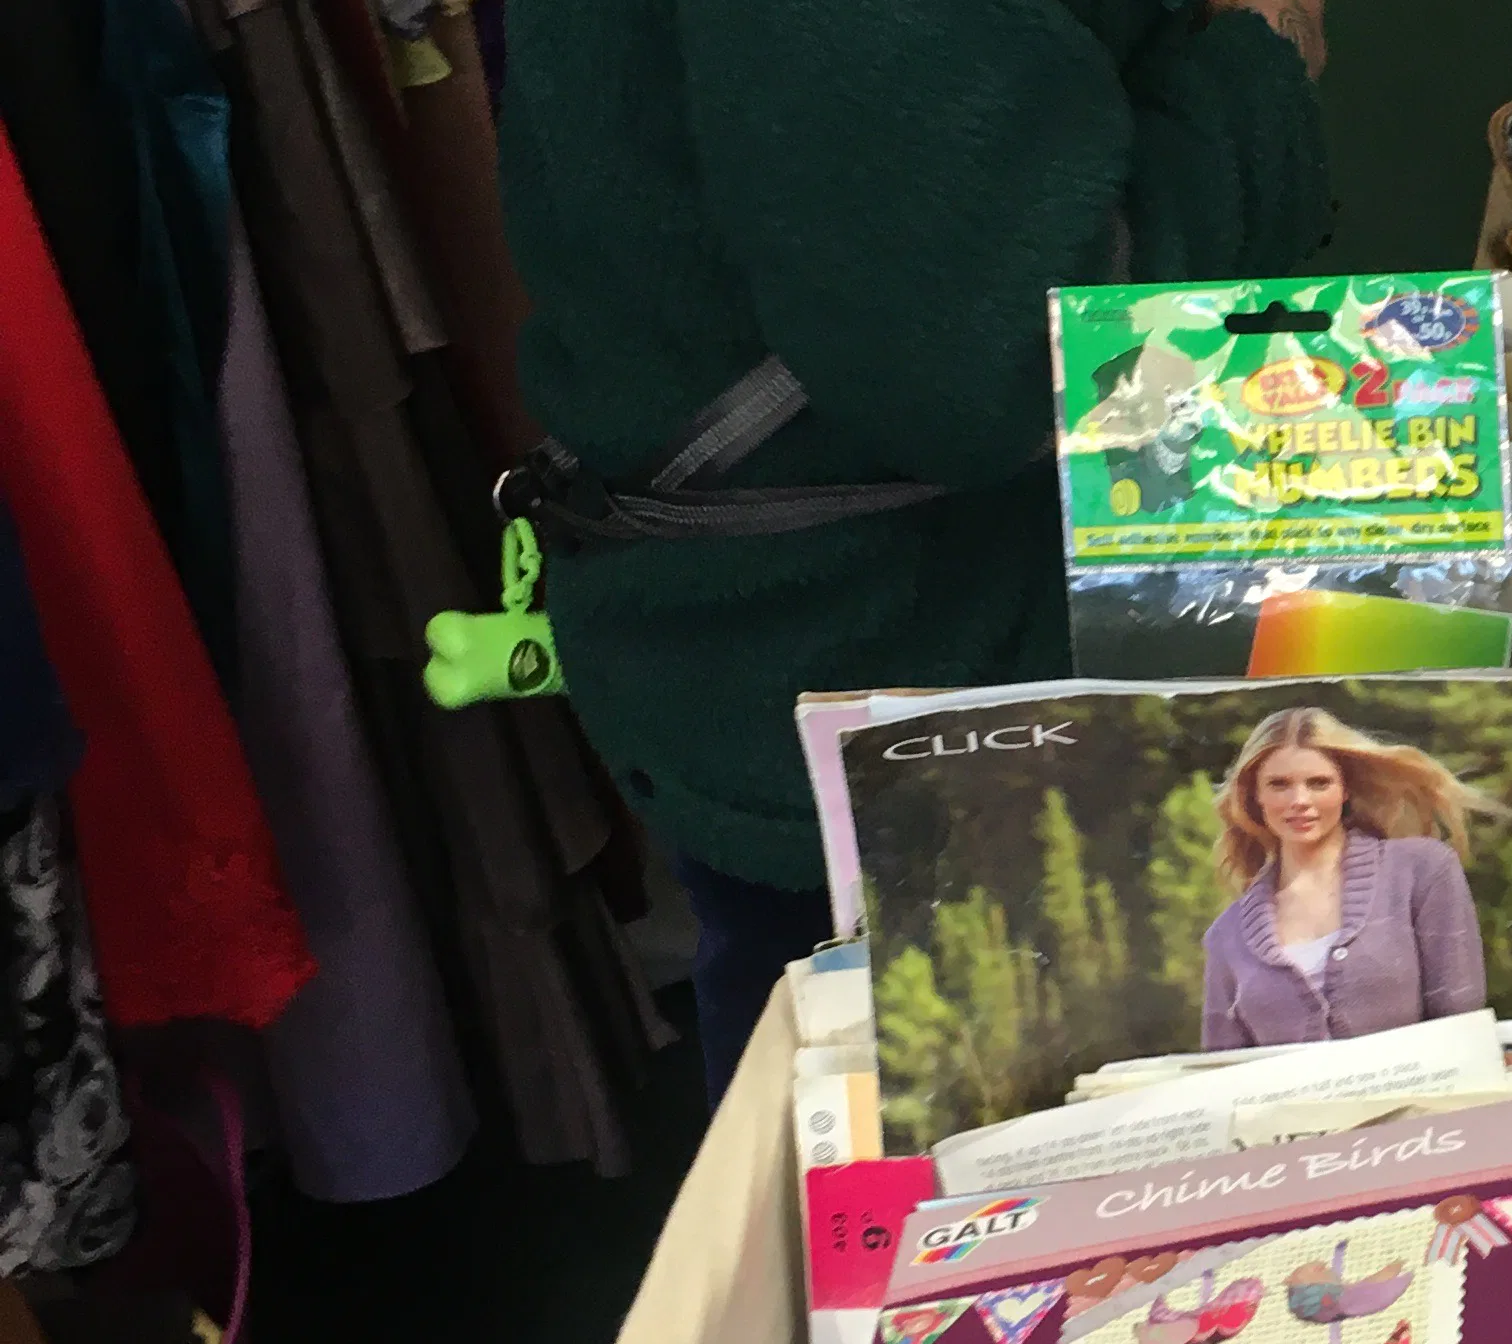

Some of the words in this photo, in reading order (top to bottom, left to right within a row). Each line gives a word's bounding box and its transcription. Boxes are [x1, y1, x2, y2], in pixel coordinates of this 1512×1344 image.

[1350, 359, 1389, 408] 2
[1230, 419, 1398, 455] WHEELIE
[1407, 415, 1477, 449] BIN
[1233, 454, 1481, 506] NUMBERS
[882, 720, 1079, 761] CLICK
[1095, 1163, 1287, 1219] Chime
[1299, 1126, 1467, 1178] Birds
[921, 1205, 1030, 1248] GALT
